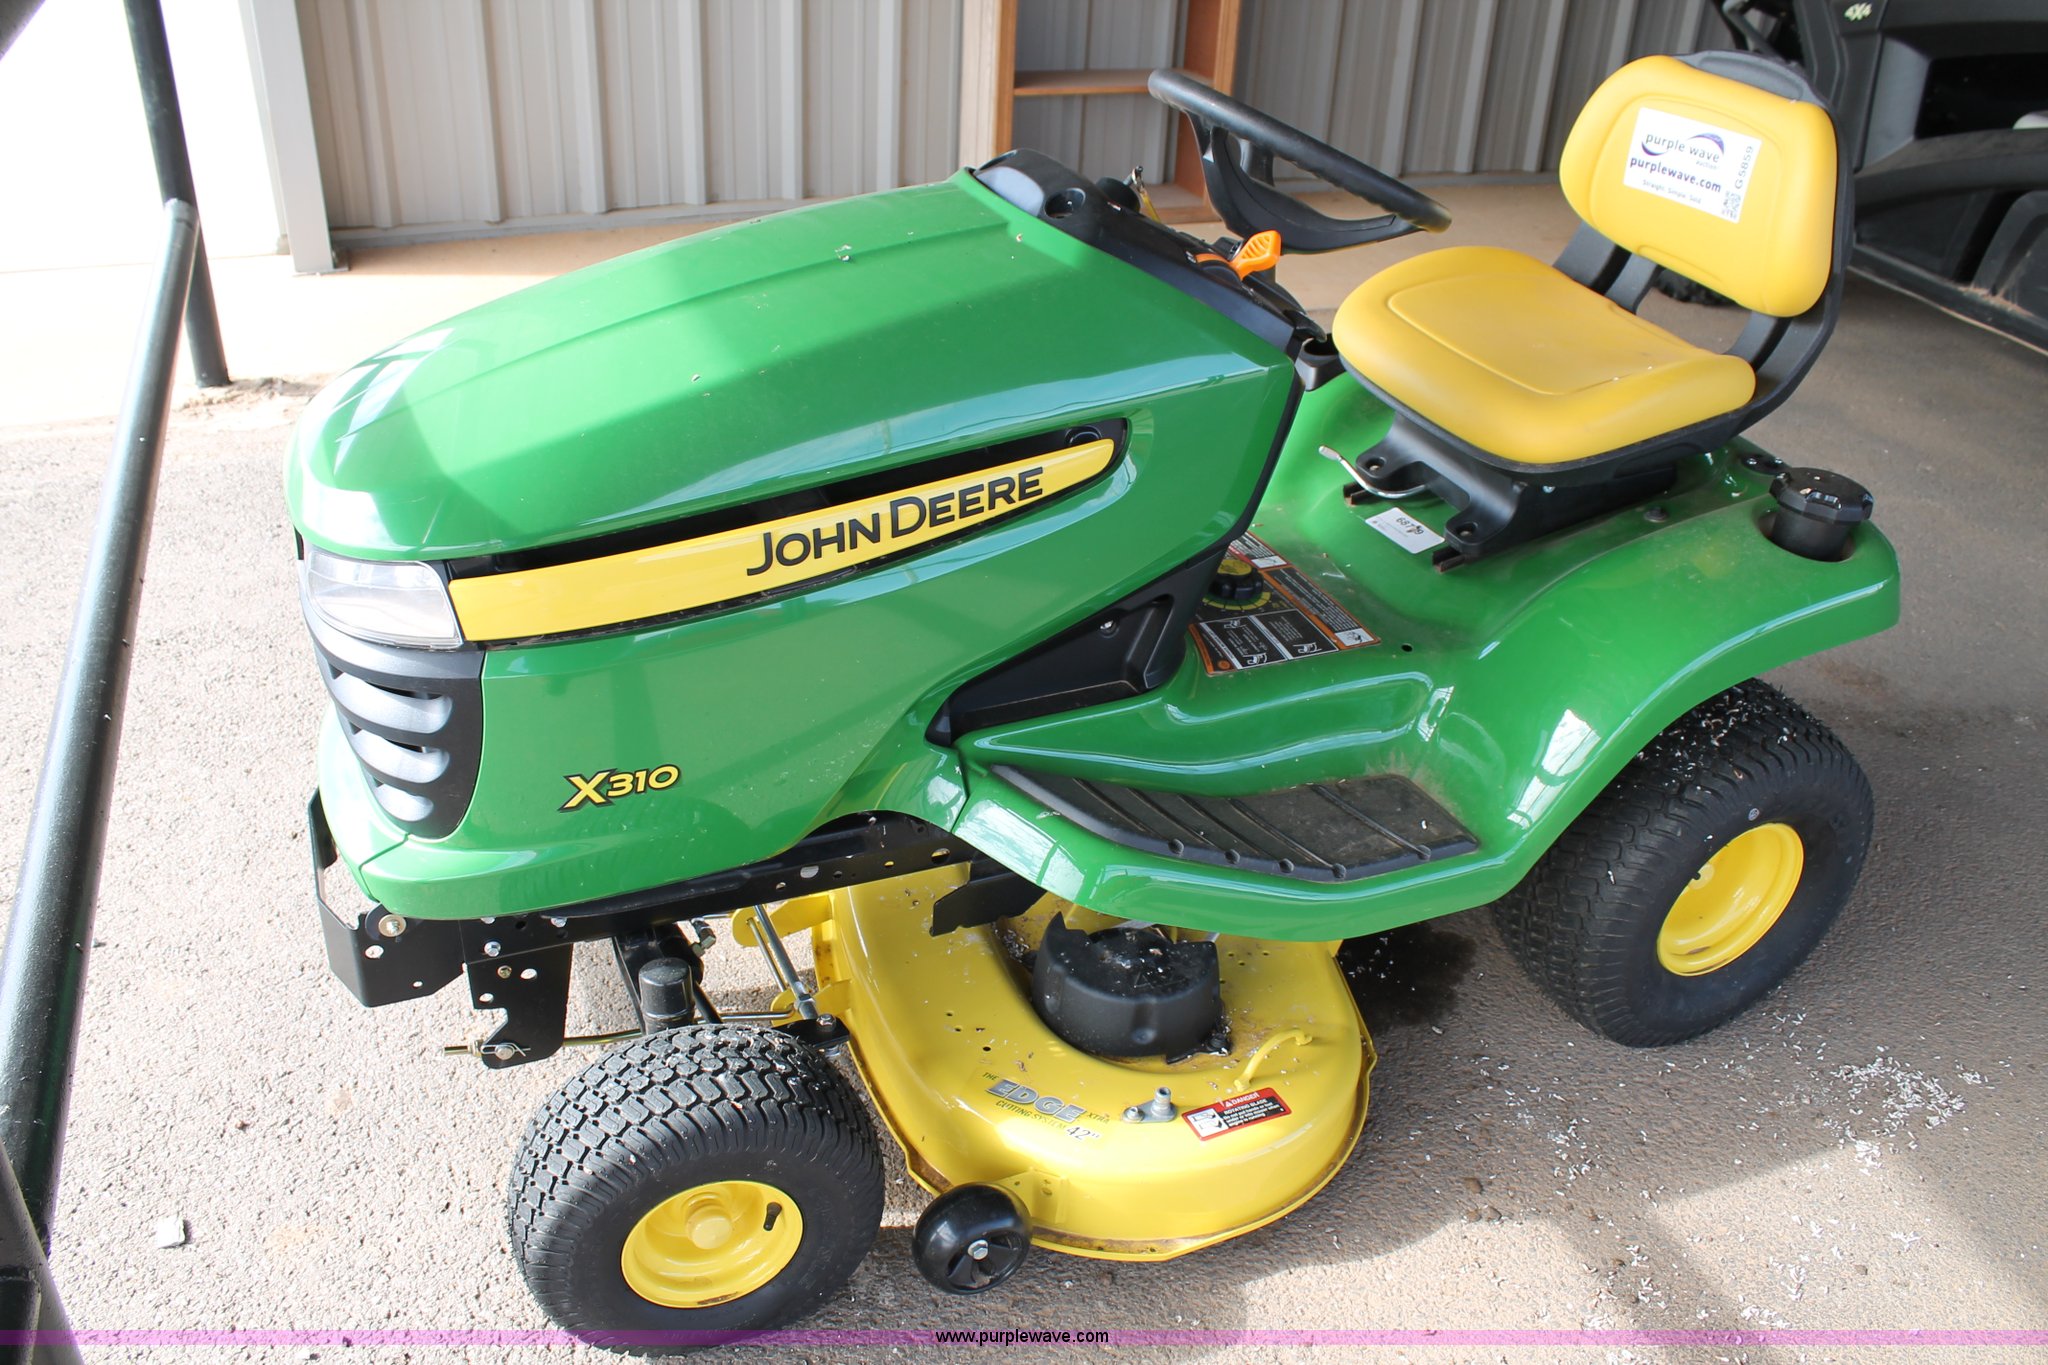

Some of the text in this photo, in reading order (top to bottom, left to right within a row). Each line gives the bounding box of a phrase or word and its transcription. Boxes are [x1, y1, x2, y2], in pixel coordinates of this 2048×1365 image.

[1645, 133, 1720, 163] purple wave
[1734, 146, 1753, 189] G5859
[1630, 156, 1722, 193] purplewave.com
[746, 466, 1043, 576] JOHN DEERE
[557, 764, 681, 813] X310
[985, 1078, 1087, 1123] EDGE
[996, 1100, 1032, 1117] CUTTING
[1232, 1092, 1260, 1105] DANGER
